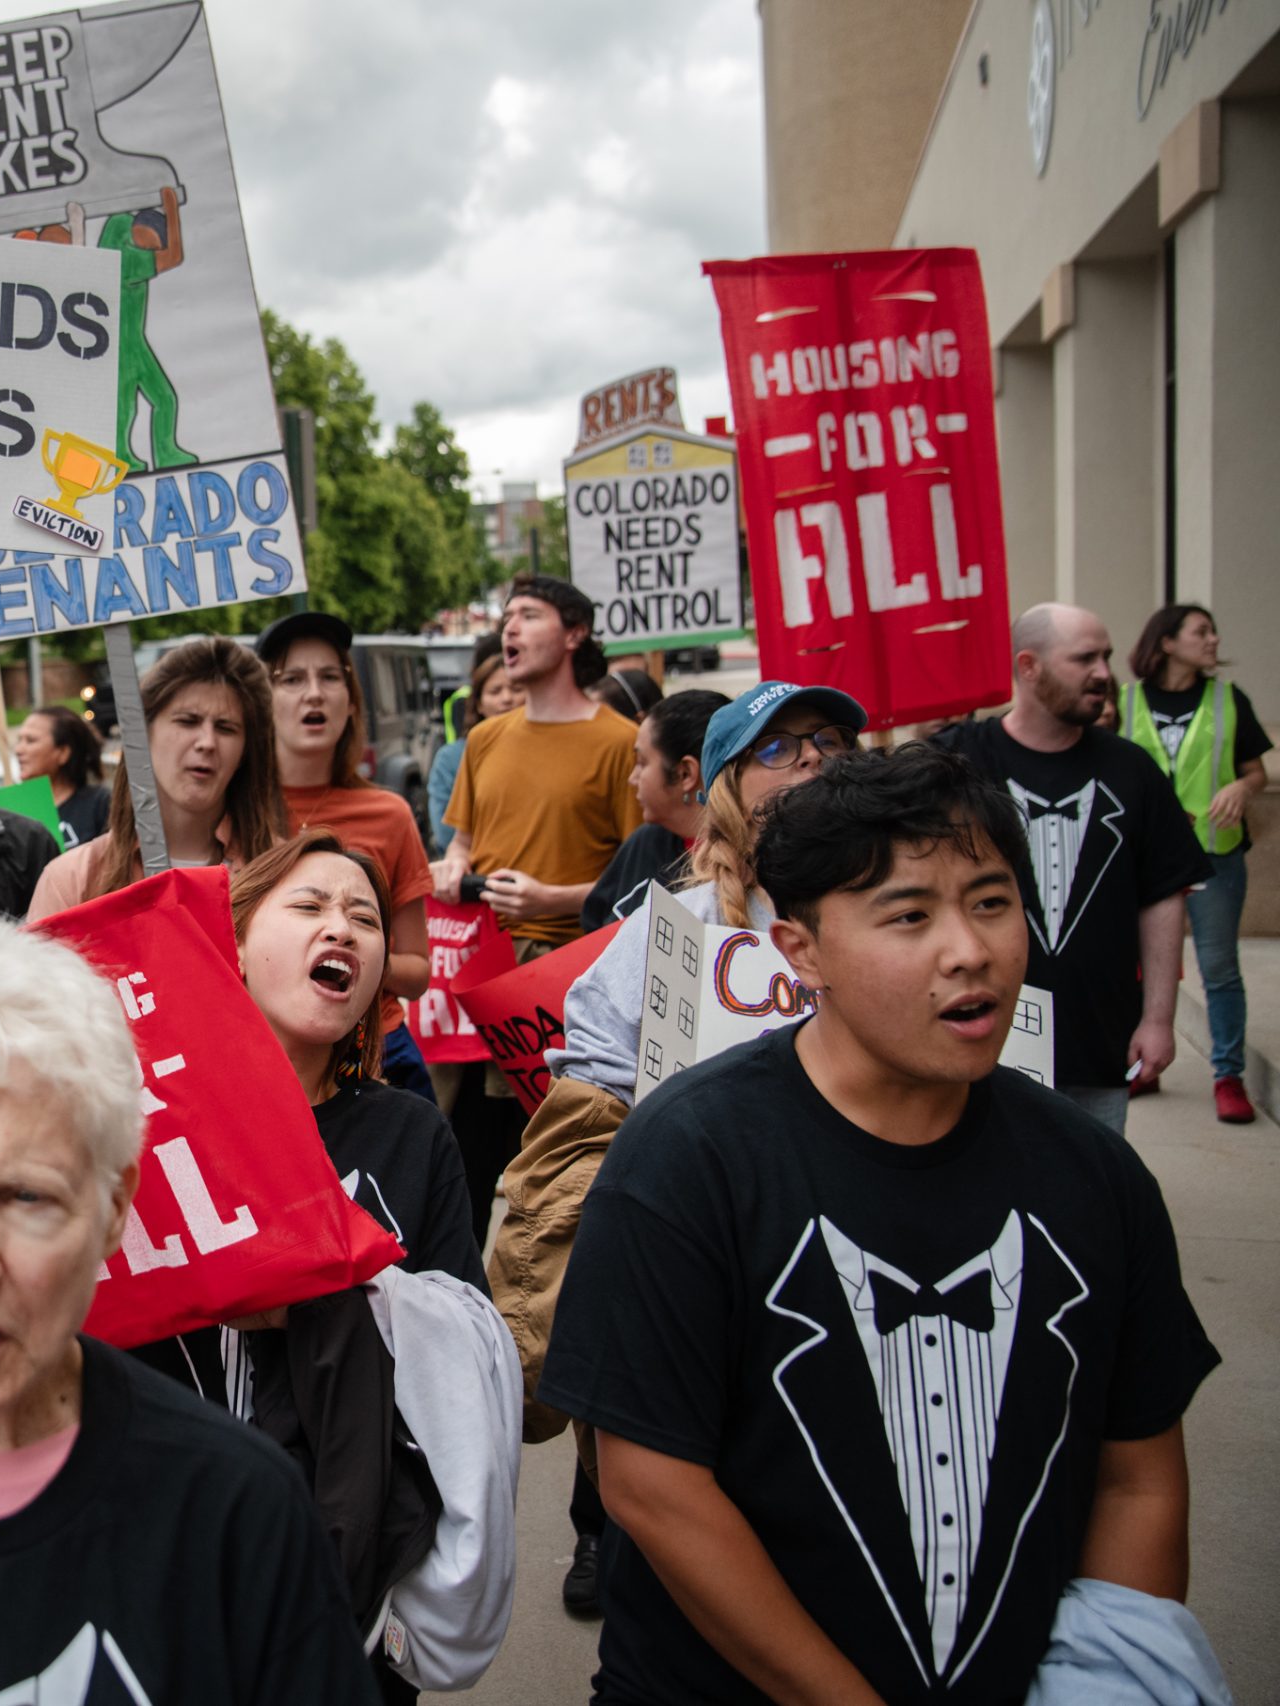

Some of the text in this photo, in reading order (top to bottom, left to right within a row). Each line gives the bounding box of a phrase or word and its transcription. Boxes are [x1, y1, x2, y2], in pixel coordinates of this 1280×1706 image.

[750, 328, 961, 400] HOUSING
[575, 471, 731, 518] COLORADO
[17, 499, 100, 548] EVICTION
[603, 513, 703, 553] NEEDS
[616, 550, 695, 593] RENT
[773, 482, 984, 629] ALL
[592, 588, 732, 637] CONTROL
